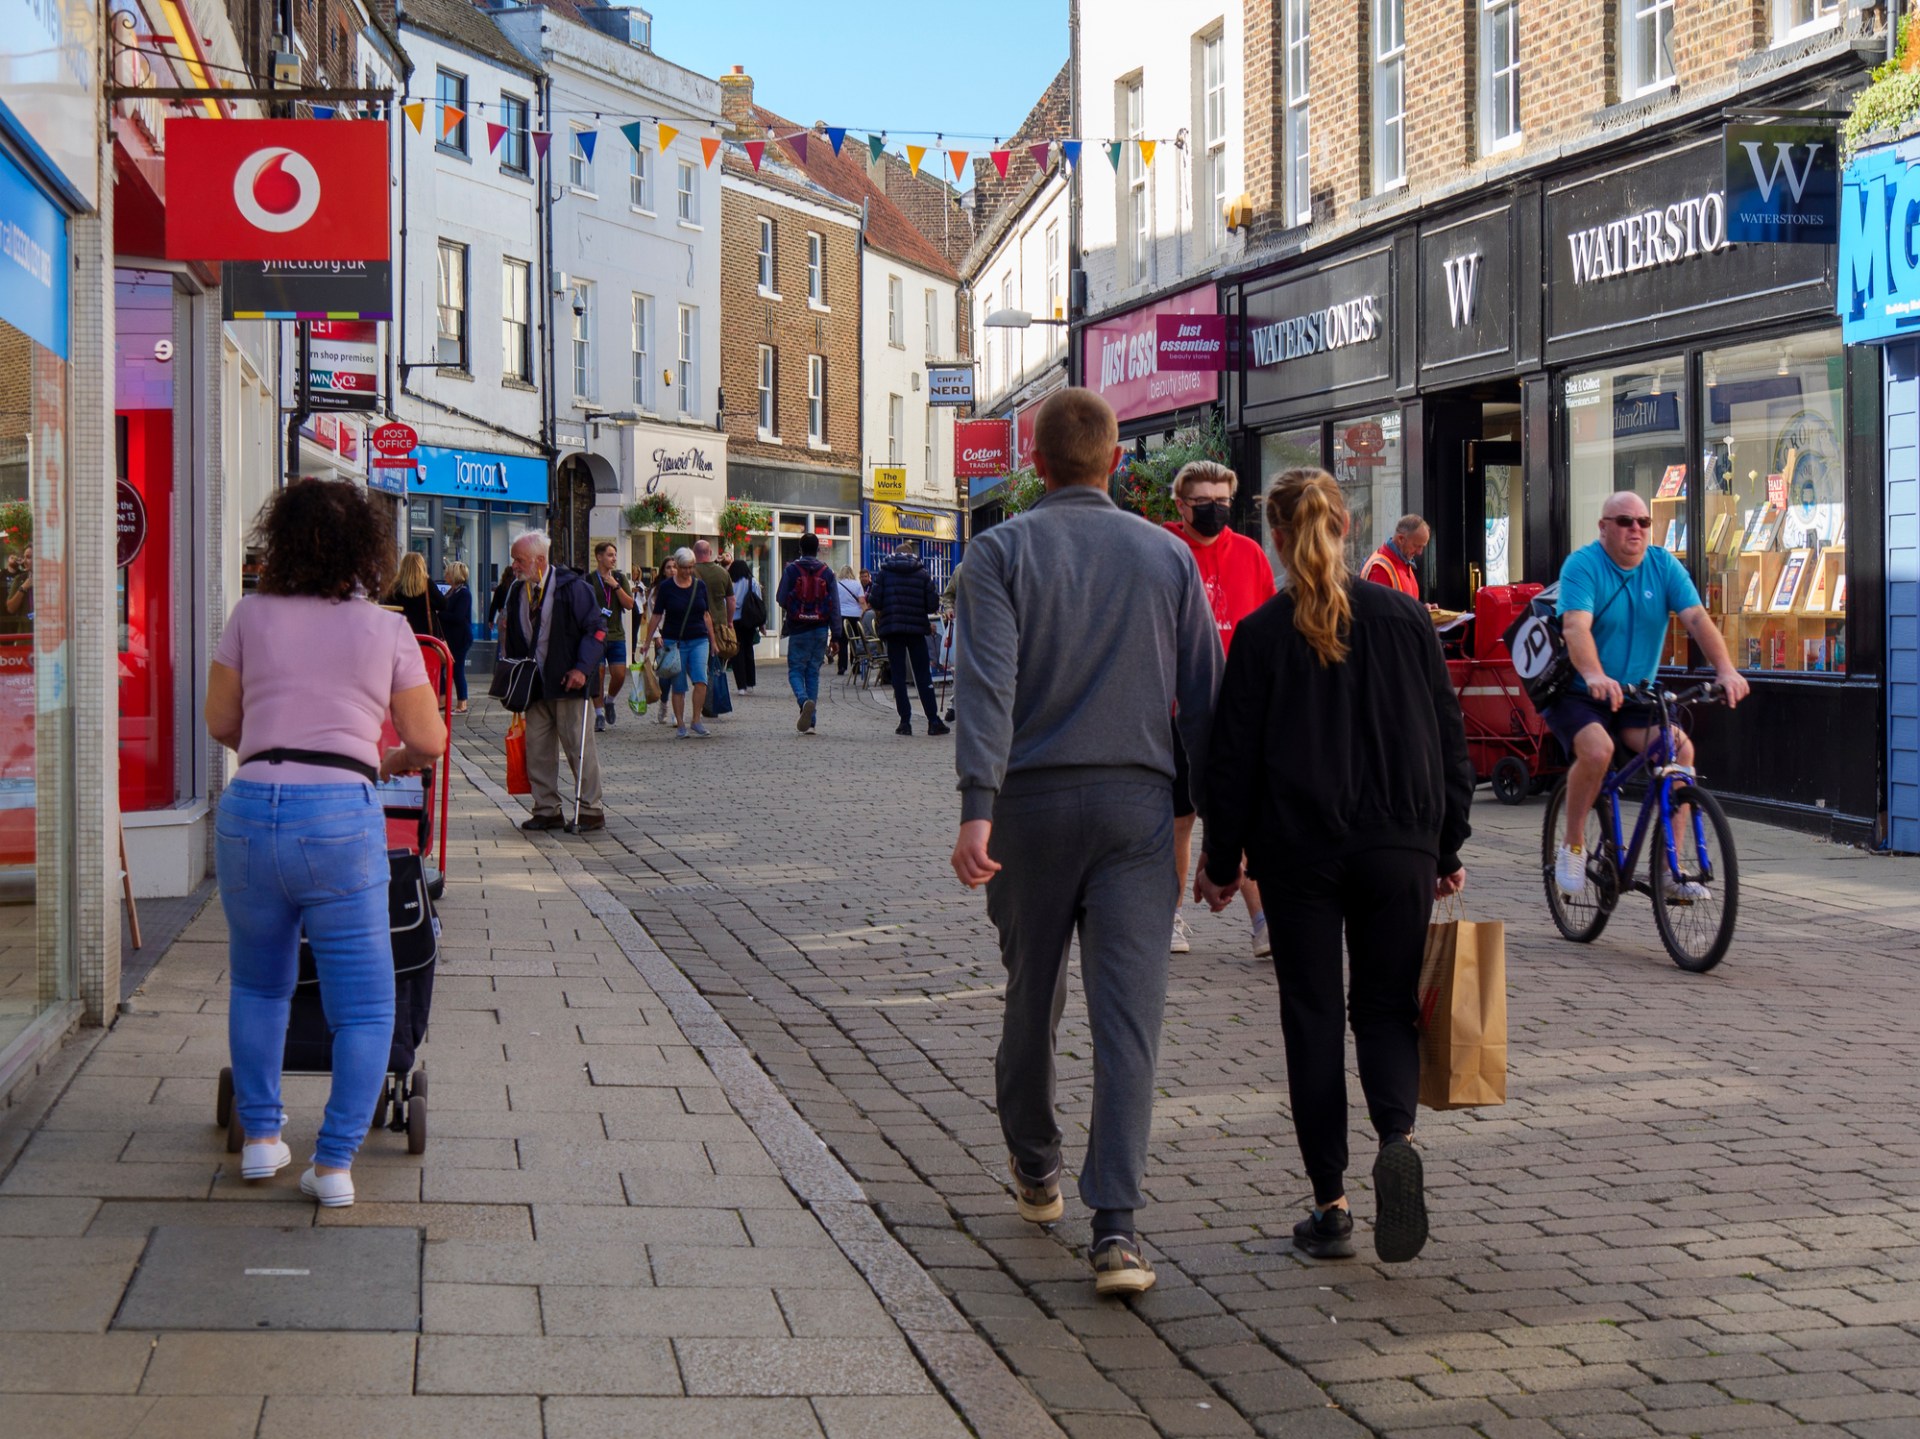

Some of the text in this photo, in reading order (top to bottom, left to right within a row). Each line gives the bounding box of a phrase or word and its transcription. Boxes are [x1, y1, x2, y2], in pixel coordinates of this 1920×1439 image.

[1739, 141, 1824, 204] W
[1740, 213, 1824, 225] WATERSTONES
[1568, 193, 1725, 285] WATERSTO
[1443, 252, 1478, 328] W
[1178, 324, 1202, 338] just
[1251, 295, 1378, 367] WATERSTONES
[1160, 339, 1220, 352] essentials
[320, 351, 339, 362] shop
[340, 353, 374, 363] premises
[1100, 333, 1127, 394] just
[1169, 353, 1192, 361] beauty
[931, 386, 971, 395] NERO
[1150, 371, 1201, 399] beauty stores
[1582, 378, 1600, 391] Collect
[383, 429, 408, 438] POST
[377, 440, 412, 448] OFFICE
[962, 448, 1002, 462] Cotton
[454, 455, 497, 486] Tamar
[878, 481, 902, 489] Works
[1768, 480, 1783, 491] HALF
[121, 501, 133, 510] the
[127, 513, 136, 522] 13
